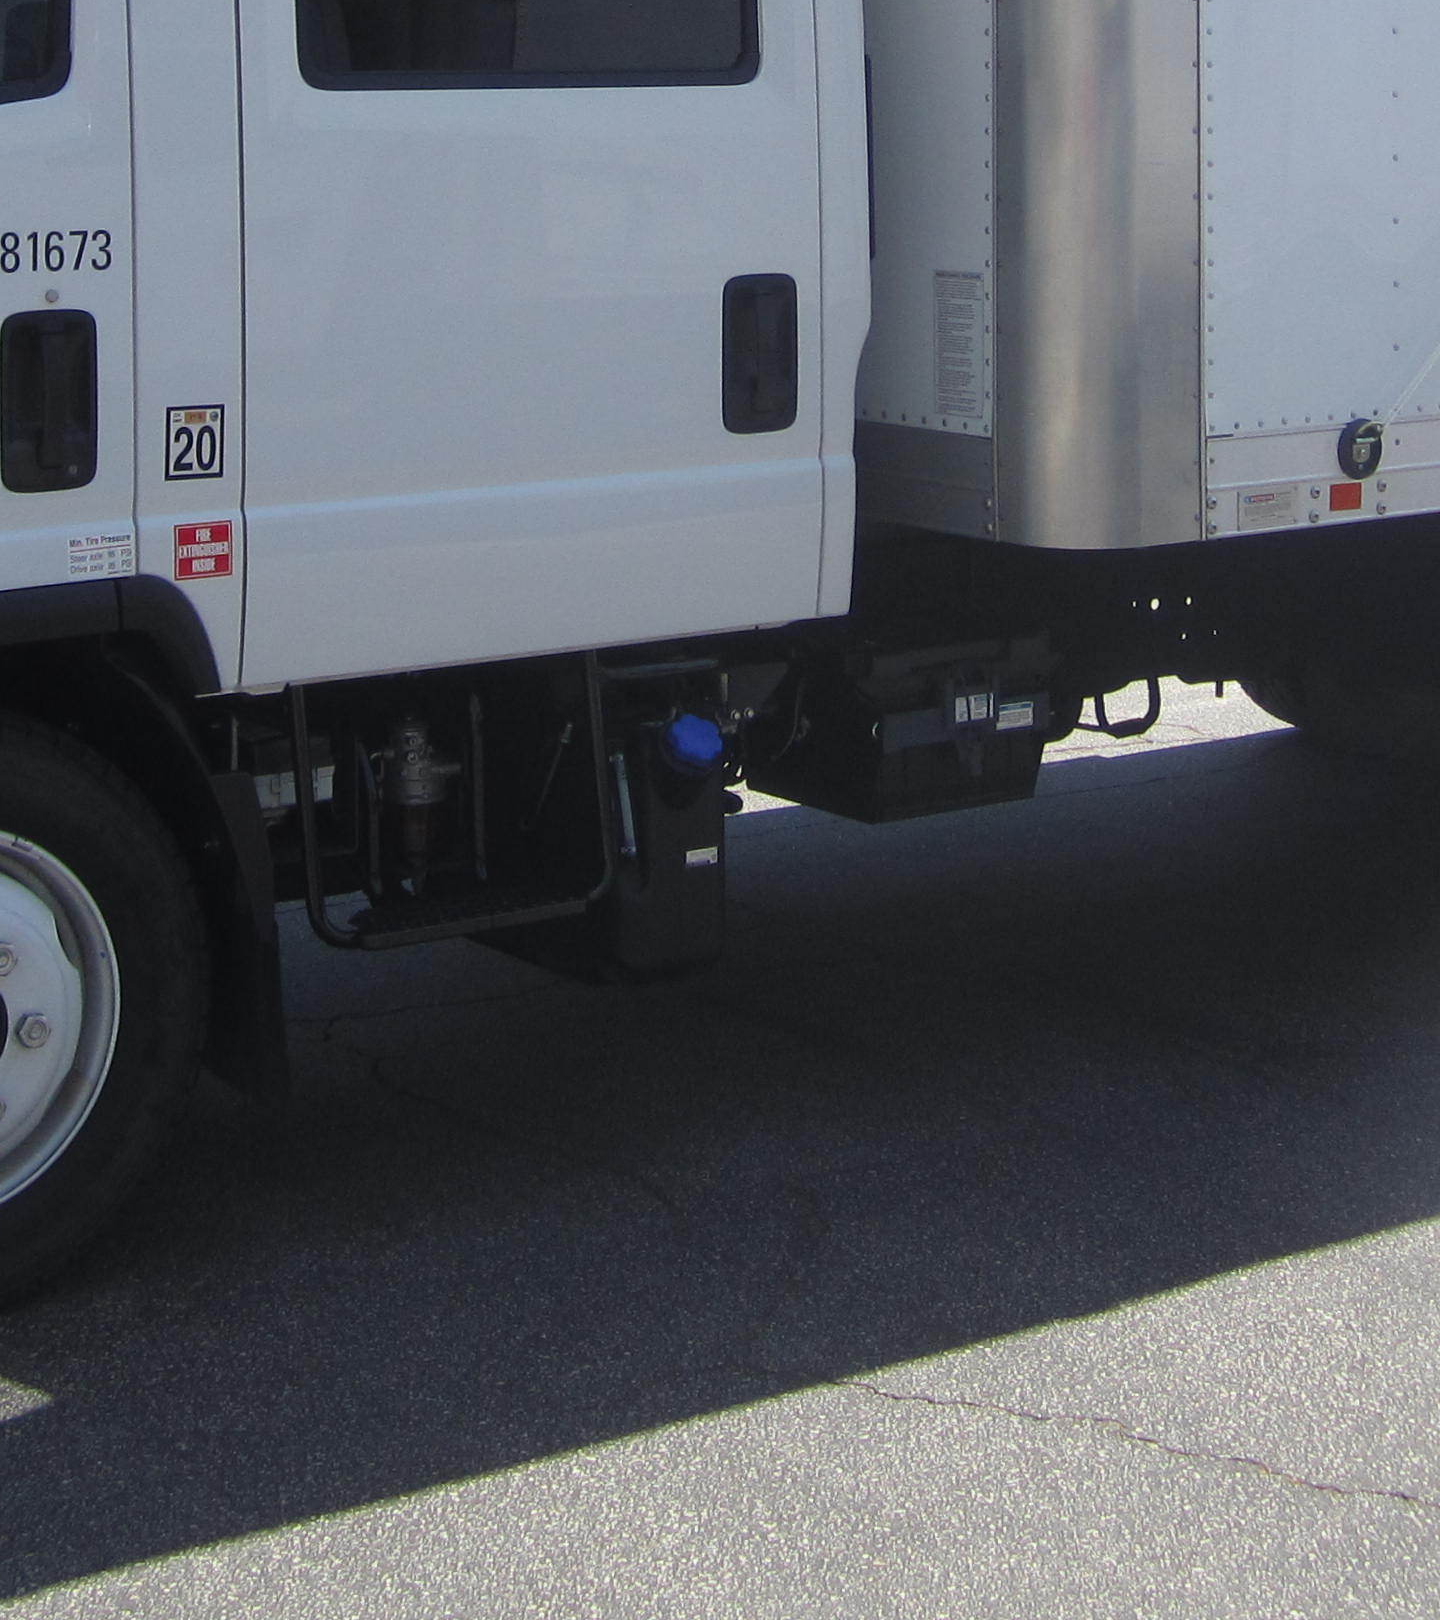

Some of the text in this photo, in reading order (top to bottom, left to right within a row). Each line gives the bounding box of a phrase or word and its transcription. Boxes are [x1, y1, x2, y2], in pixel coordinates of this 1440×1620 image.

[173, 425, 216, 471] 20
[85, 536, 99, 546] Tire
[100, 534, 131, 545] Pressure
